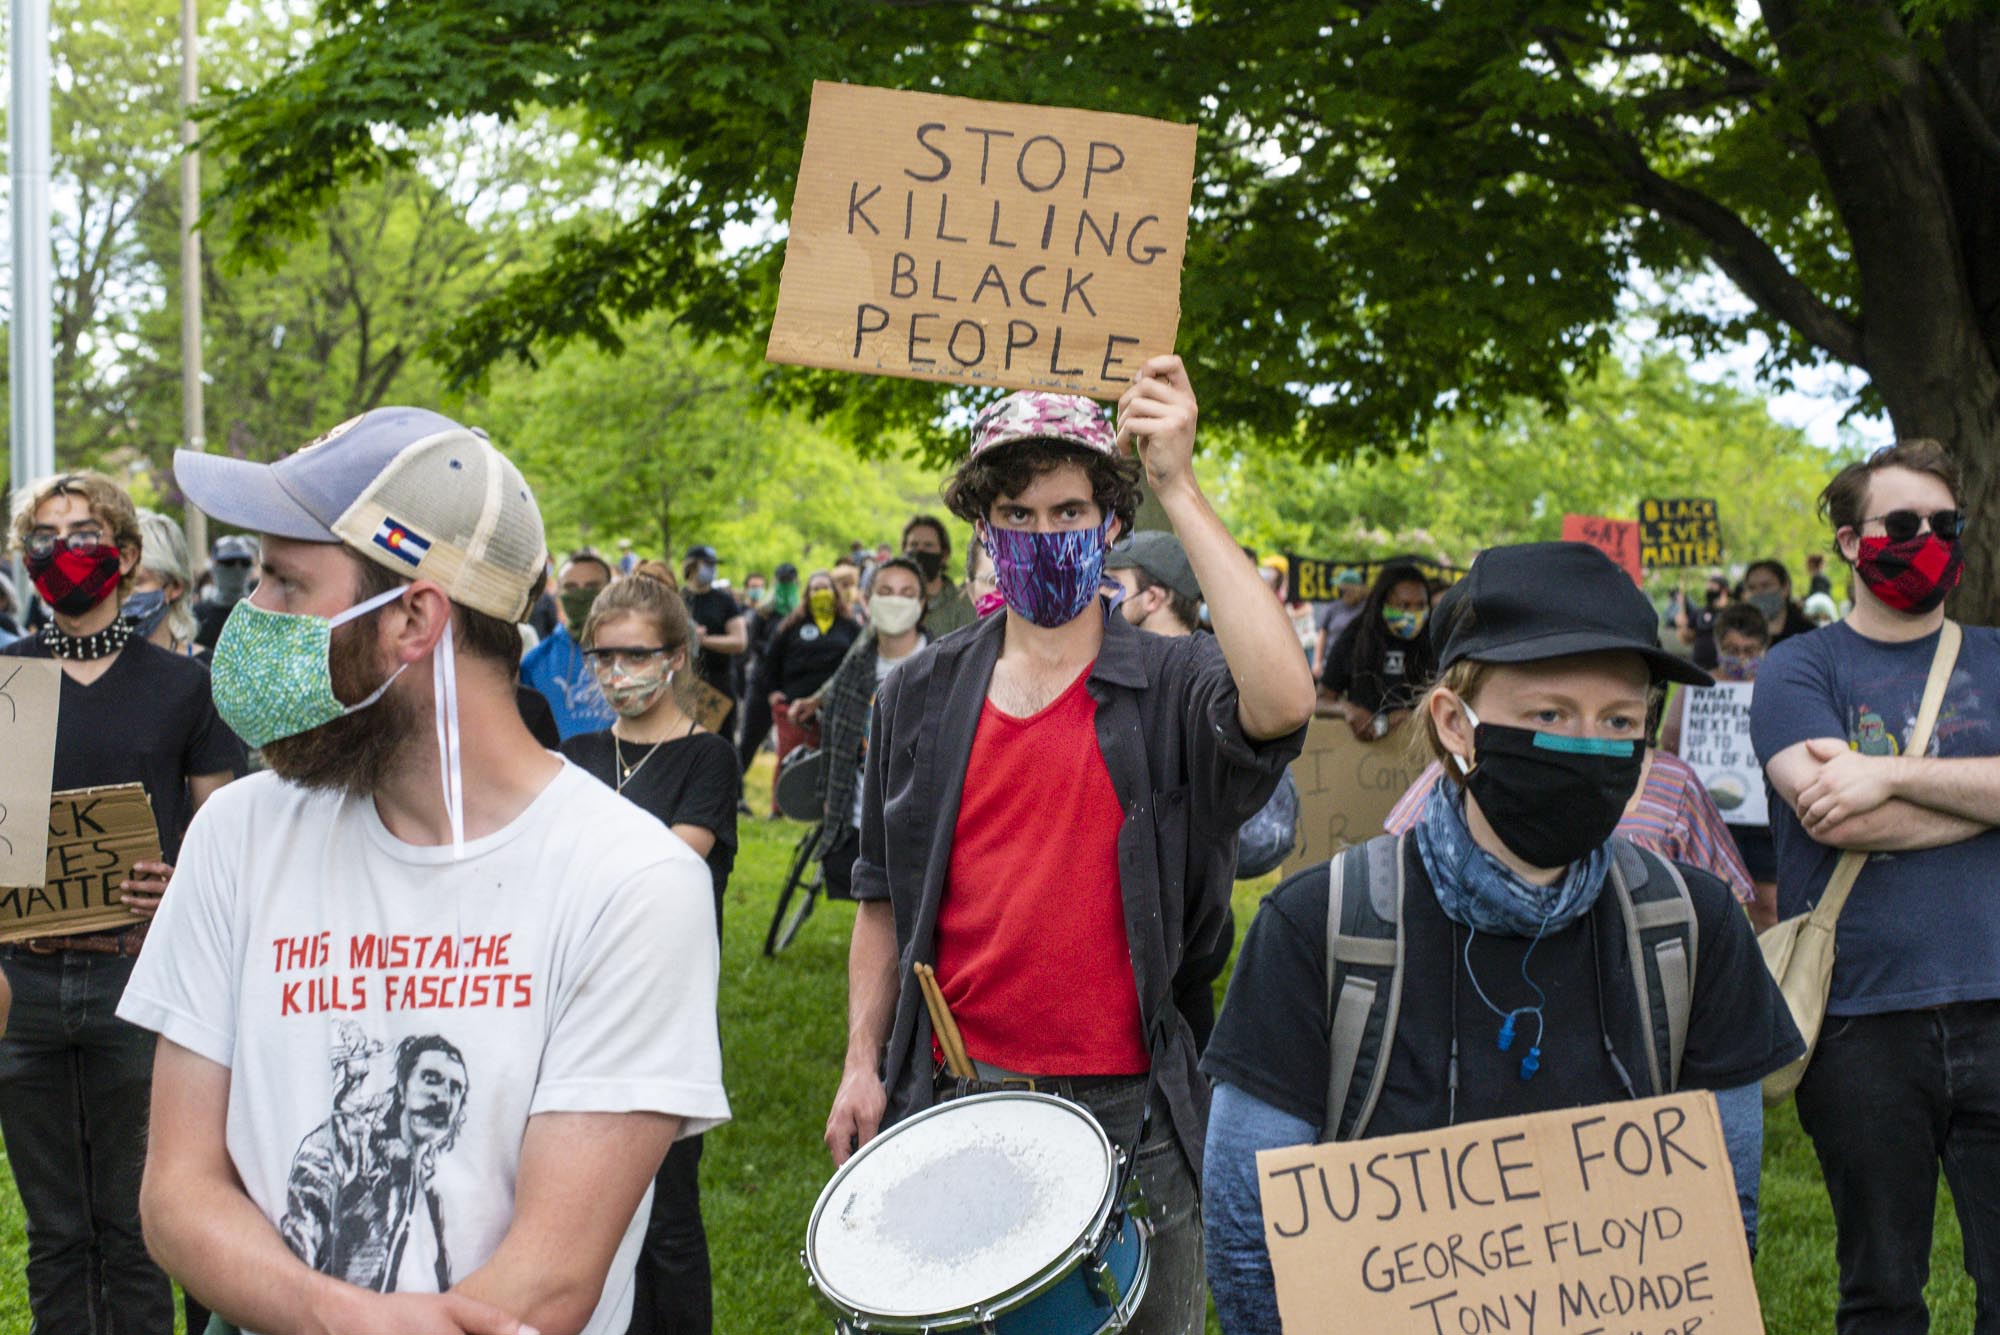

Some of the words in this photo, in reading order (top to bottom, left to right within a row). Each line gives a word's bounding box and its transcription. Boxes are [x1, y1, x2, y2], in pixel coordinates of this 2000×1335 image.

[904, 123, 1125, 199] STOP
[848, 181, 1168, 265] KILLING
[890, 252, 1097, 317] BLACK
[854, 304, 1140, 382] PEOPLE
[1644, 500, 1713, 521] BLACK
[1640, 521, 1716, 543] LIVES
[1641, 540, 1722, 567] MATTER
[1690, 703, 1750, 716] HAPPEN
[1694, 688, 1734, 700] WHAT
[1687, 735, 1706, 746] UP
[1714, 736, 1732, 749] TO
[1689, 719, 1729, 731] NEXT
[1735, 722, 1749, 735] IS
[1687, 752, 1713, 765] ALL
[1721, 754, 1740, 767] OF
[273, 931, 330, 973] THIS
[350, 933, 512, 970] MUSTACHE
[281, 976, 366, 1016] KILLS
[385, 974, 532, 1012] FASCISTS
[1269, 1132, 1541, 1238] JUSTICE
[1571, 1106, 1707, 1191] FOR
[1361, 1223, 1532, 1293] GEORGE
[1544, 1206, 1683, 1265] FLOYD
[1409, 1289, 1537, 1335] TONY
[1558, 1261, 1713, 1327] McDADE
